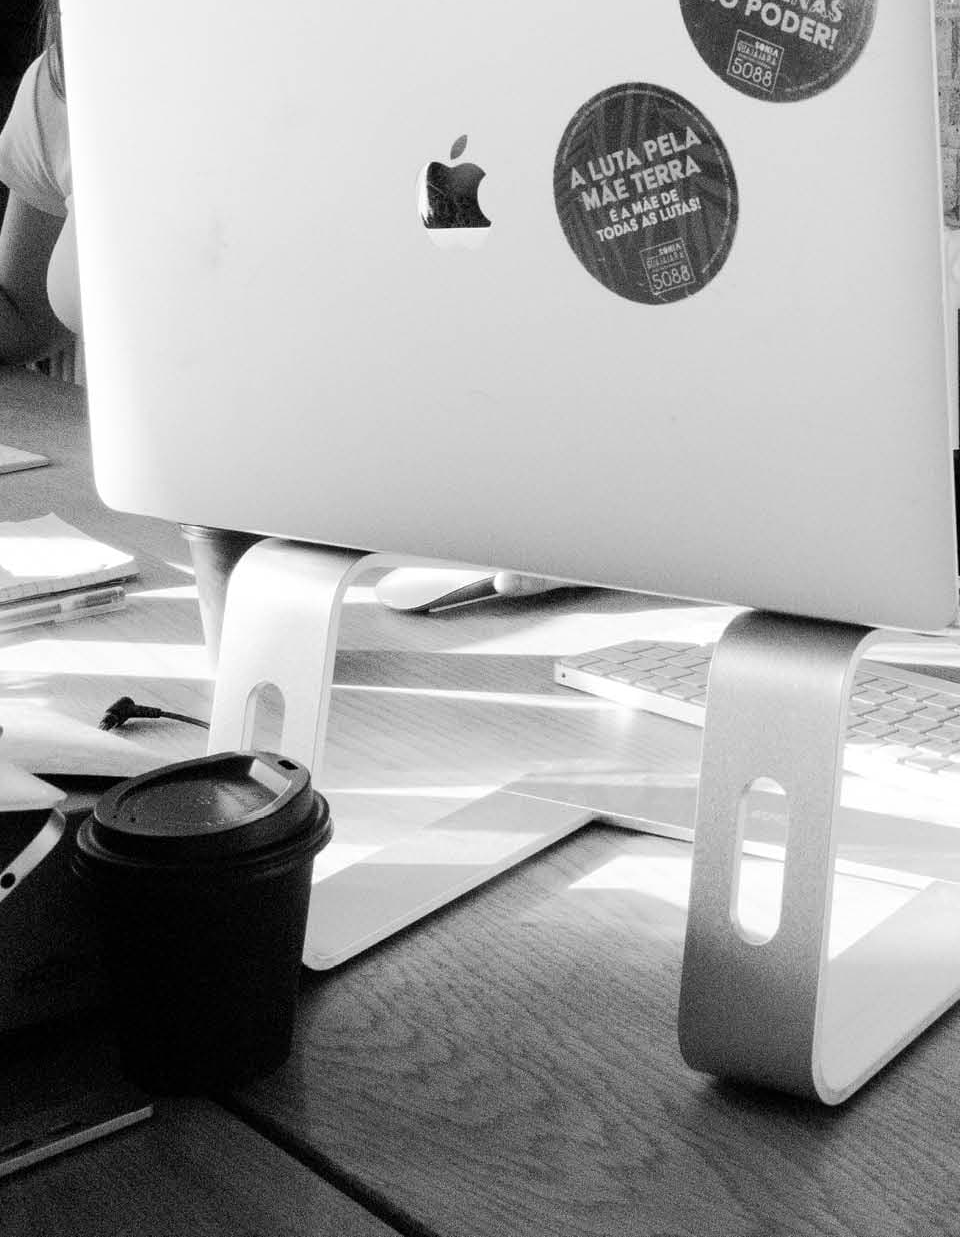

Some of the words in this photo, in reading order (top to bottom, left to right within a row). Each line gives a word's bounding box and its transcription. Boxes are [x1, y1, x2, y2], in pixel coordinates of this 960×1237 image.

[731, 57, 773, 88] 5088
[570, 166, 586, 190] A
[587, 147, 643, 182] LUTA
[642, 125, 701, 162] PELA
[580, 177, 630, 212] MÃE
[629, 155, 701, 194] TERRA
[596, 218, 639, 242] TODAS
[641, 212, 659, 228] AS
[658, 197, 702, 223] LUTAS!
[620, 205, 632, 220] A
[660, 188, 680, 206] DE
[651, 264, 691, 291] 5088
